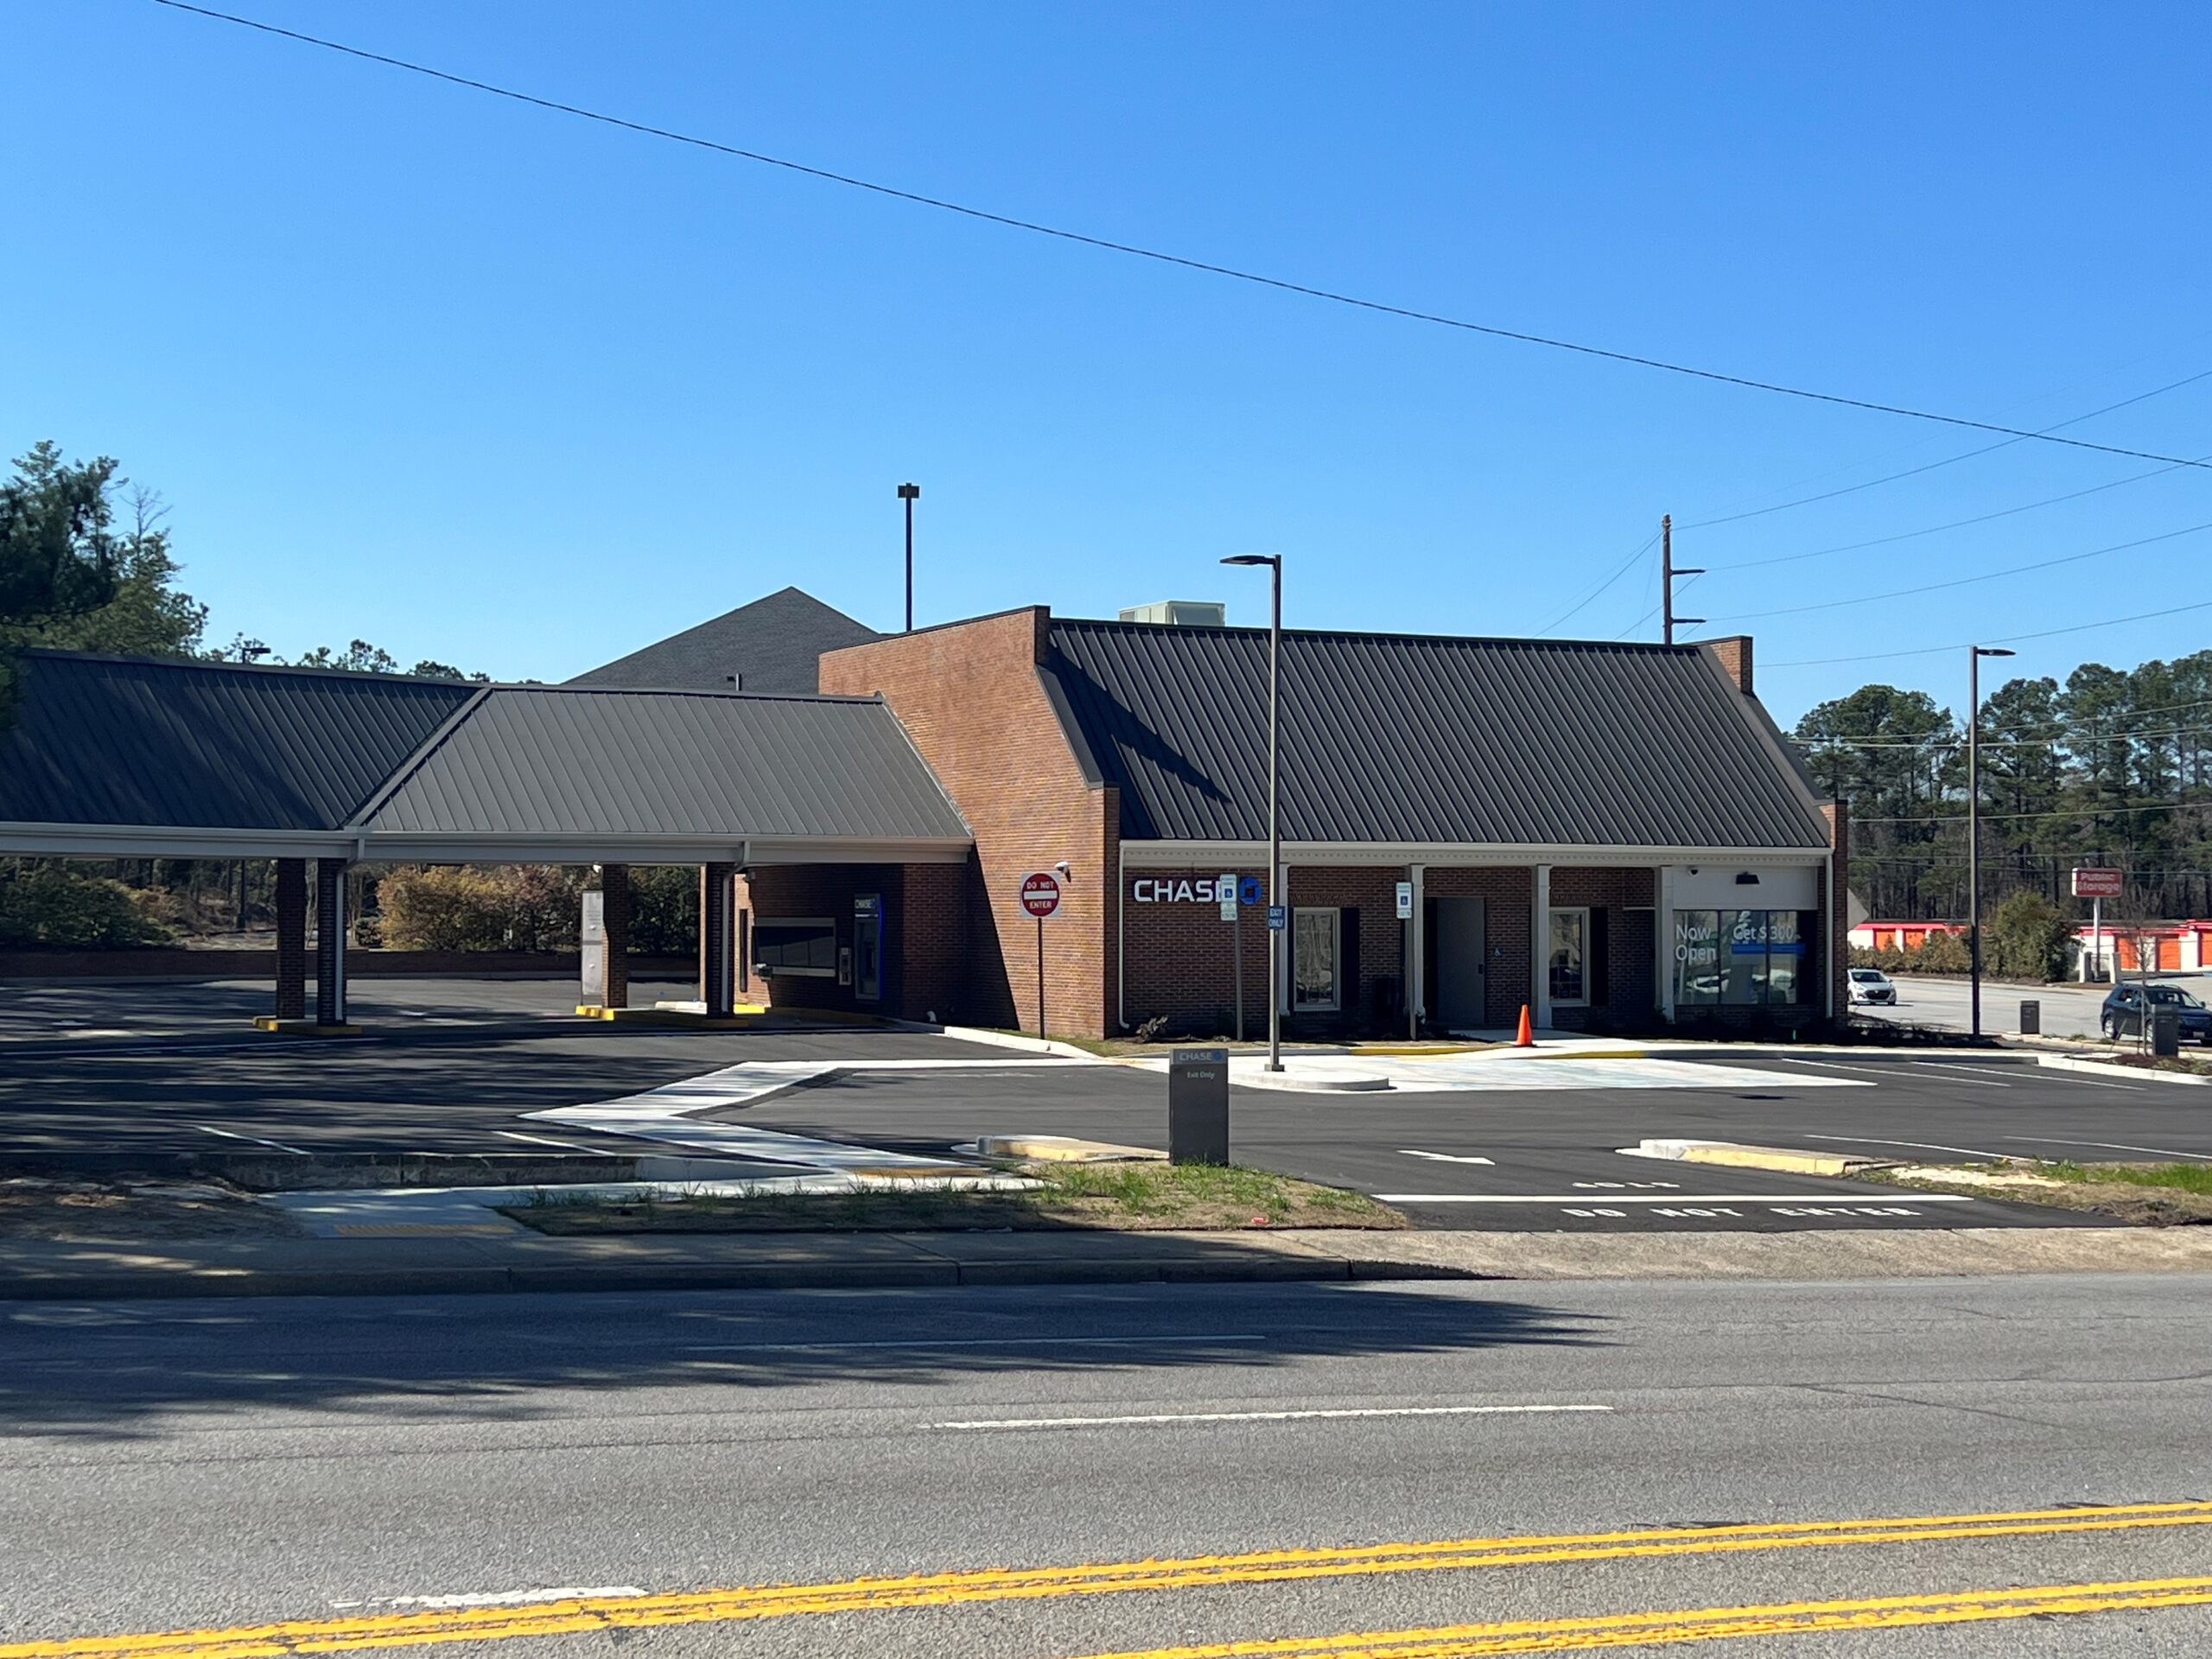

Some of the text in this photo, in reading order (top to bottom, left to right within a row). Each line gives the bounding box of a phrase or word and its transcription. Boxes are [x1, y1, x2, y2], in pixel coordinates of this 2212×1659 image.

[2081, 873, 2115, 881] Public
[1027, 881, 1054, 890] DO NOT
[2077, 881, 2120, 893] Storage
[1029, 900, 1052, 909] ENTER
[1676, 924, 1711, 941] Now
[1732, 925, 1757, 941] Get
[1675, 944, 1717, 966] Open
[1179, 1052, 1212, 1061] CHASE
[1186, 1071, 1216, 1080] Exit Only
[1560, 1207, 1923, 1217] DO NOT ENTER
